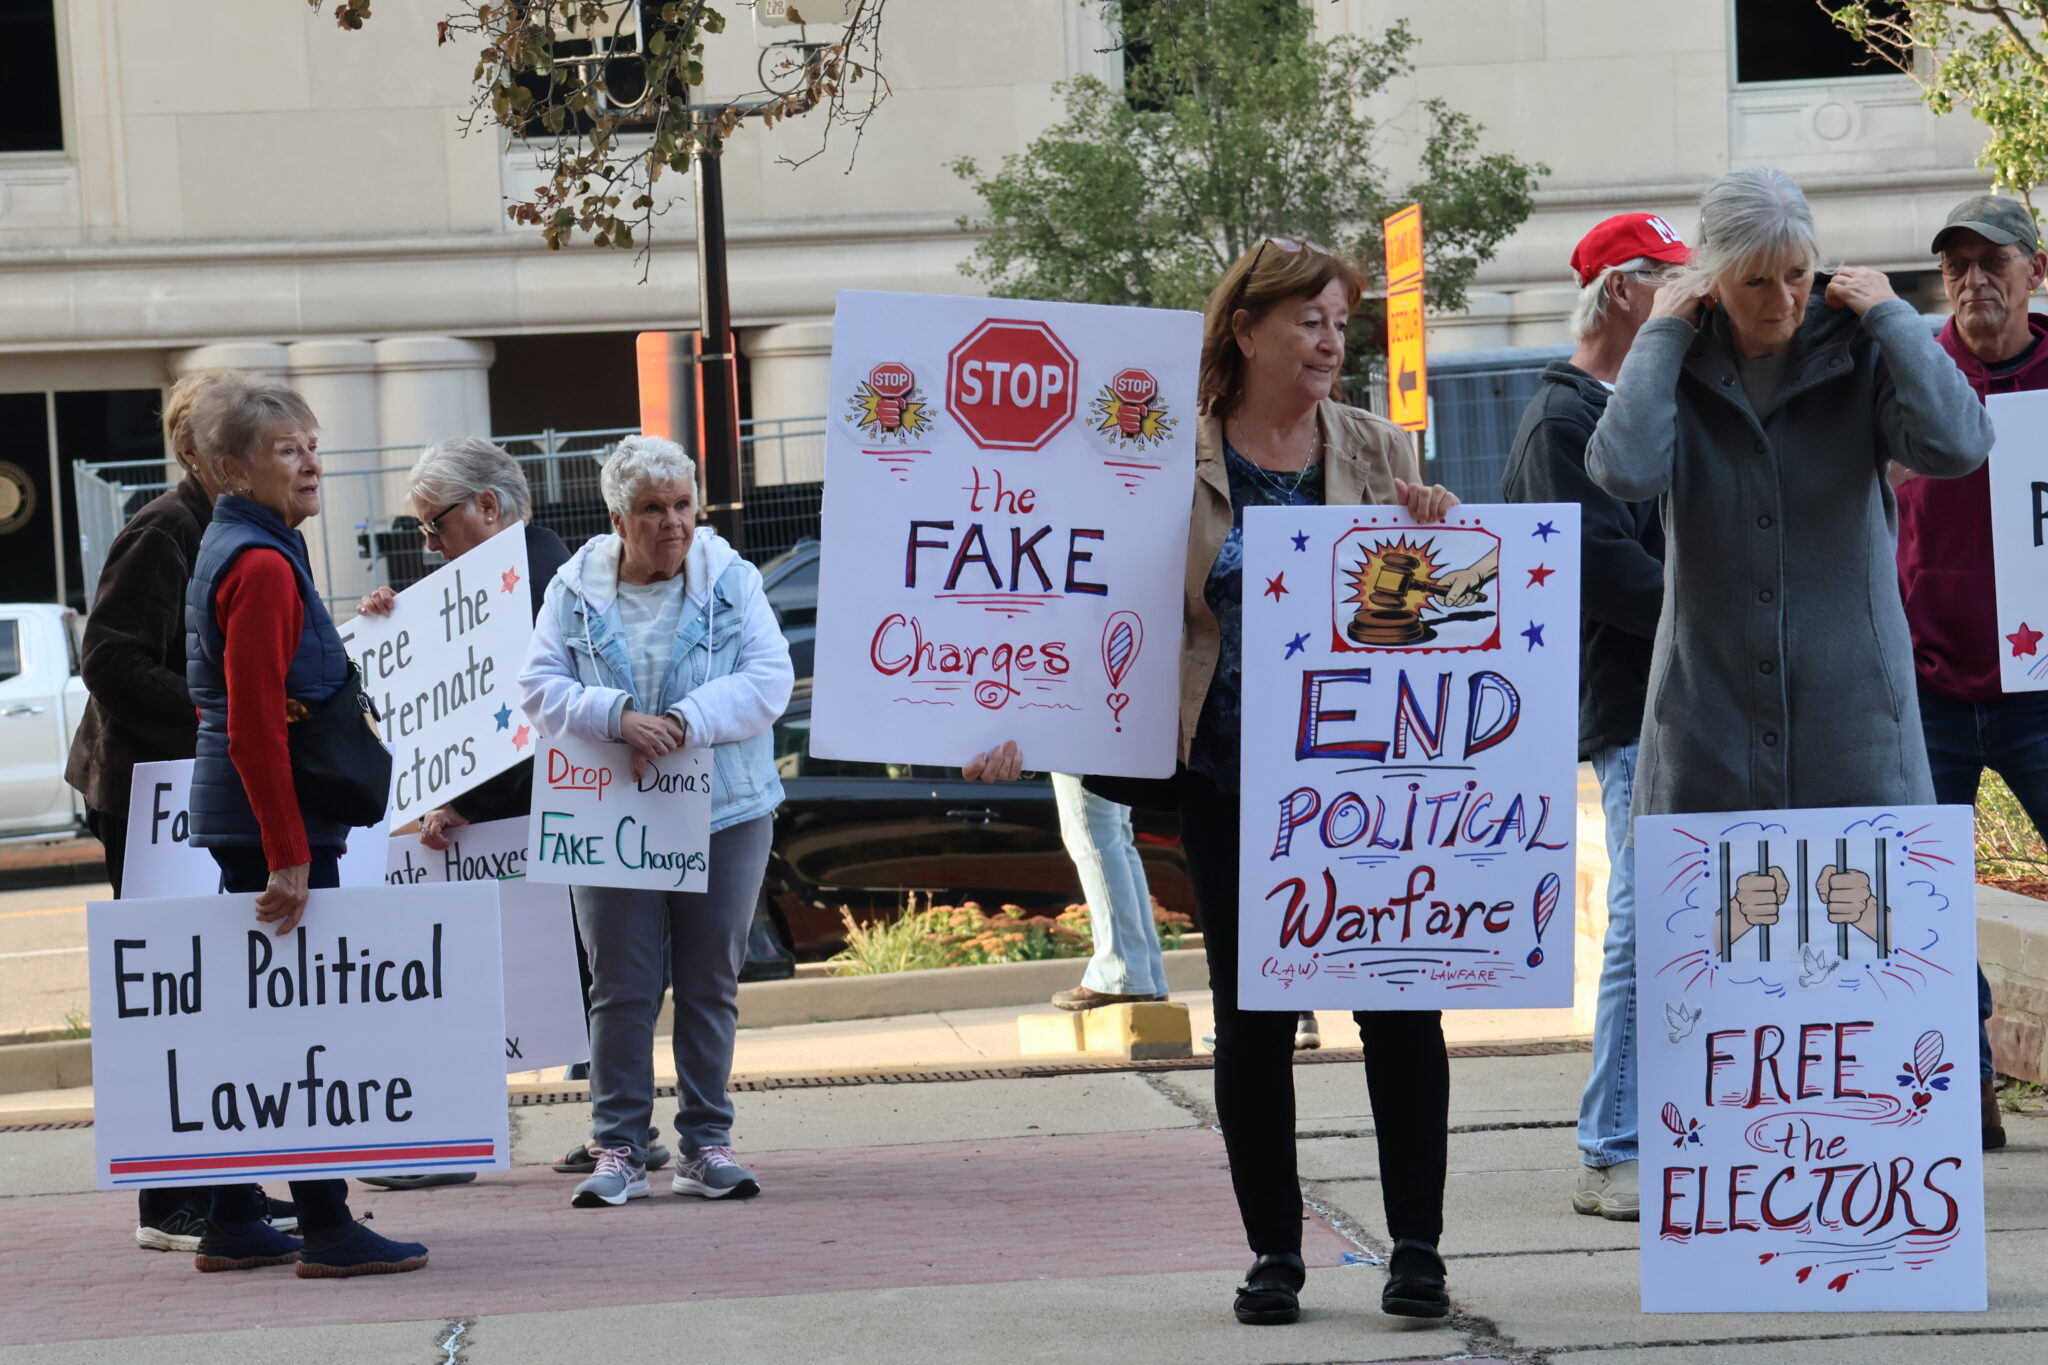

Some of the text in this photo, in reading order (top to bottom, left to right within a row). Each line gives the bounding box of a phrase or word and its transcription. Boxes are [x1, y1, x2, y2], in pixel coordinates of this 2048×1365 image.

[1391, 308, 1419, 343] DETOUR
[875, 371, 908, 388] STOP
[960, 360, 1064, 408] STOP
[1118, 377, 1151, 393] STOP
[961, 466, 1037, 514] the
[905, 520, 1108, 596] FAKE
[340, 569, 490, 689] ree the
[371, 645, 494, 742] ternate
[1295, 667, 1520, 763] END
[391, 736, 476, 811] ctors
[548, 748, 710, 801] Drop Dana's
[151, 783, 190, 844] Fa
[385, 850, 427, 885] ate
[539, 811, 706, 888] FAKE Charges
[114, 923, 443, 1018] End Political
[1430, 969, 1497, 983] LAWFARE
[167, 1045, 413, 1133] Lawfare
[1705, 1021, 1874, 1108] FREE
[1774, 1118, 1847, 1161] the
[1660, 1157, 1961, 1236] ELECTORS
